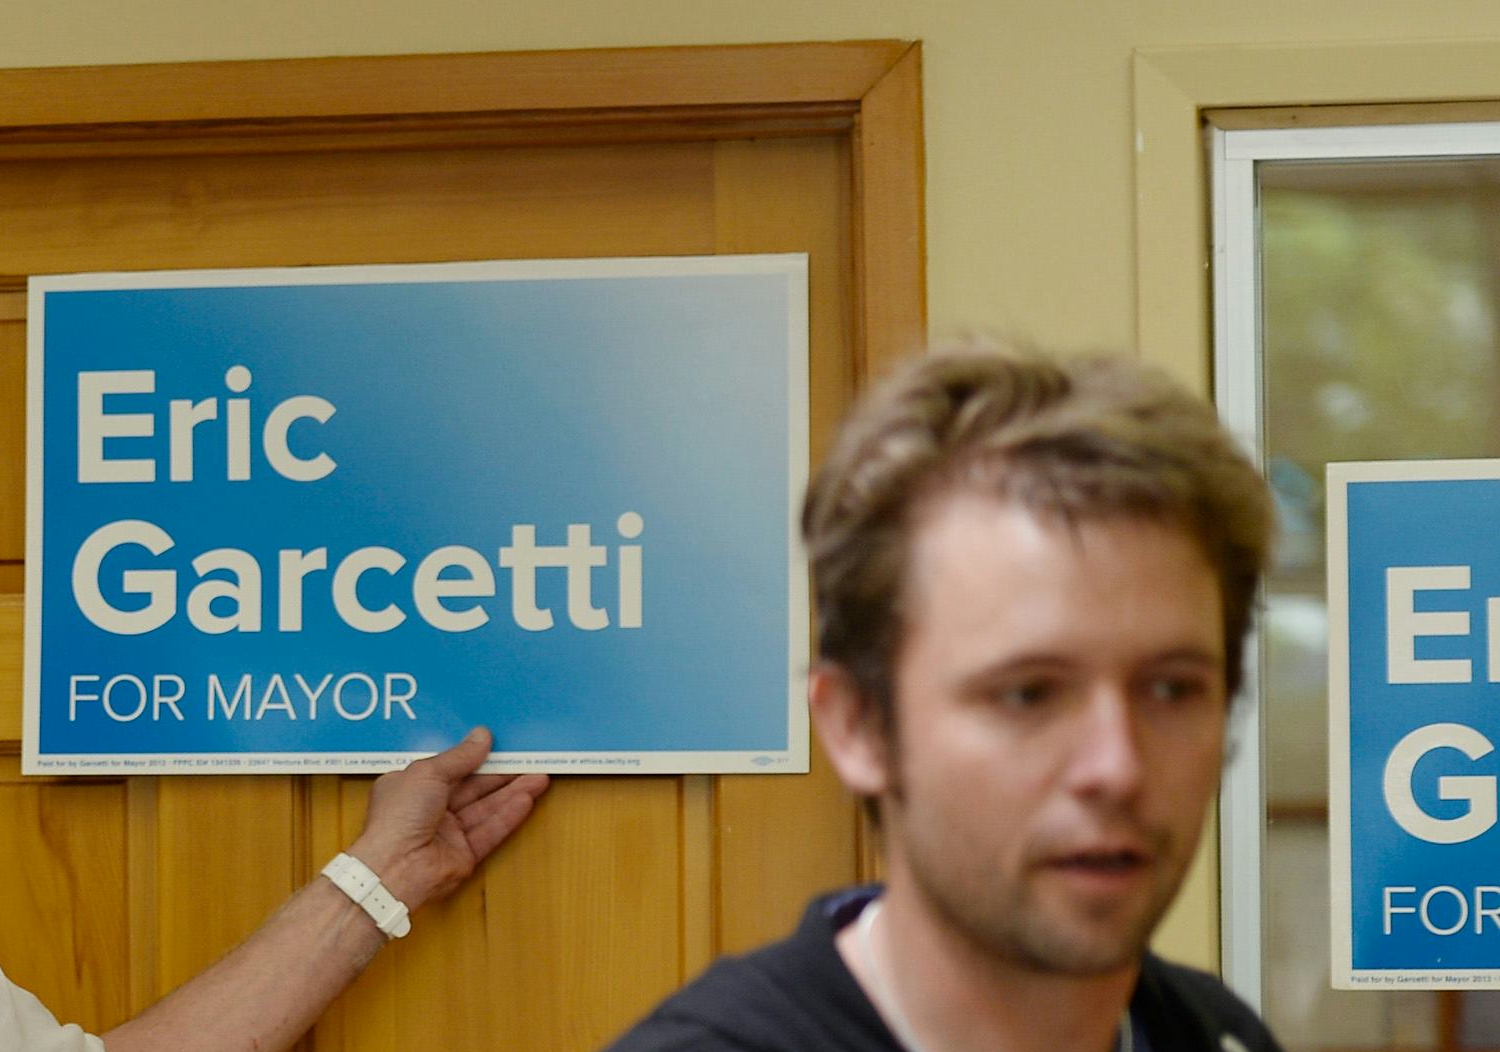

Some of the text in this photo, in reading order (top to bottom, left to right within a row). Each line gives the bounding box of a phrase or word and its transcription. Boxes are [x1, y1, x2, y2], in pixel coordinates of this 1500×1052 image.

[77, 364, 338, 484] Eric
[71, 511, 645, 636] Garcetti
[1385, 565, 1500, 685] E
[68, 672, 419, 722] FOR MAYOR
[1383, 886, 1500, 936] FOR
